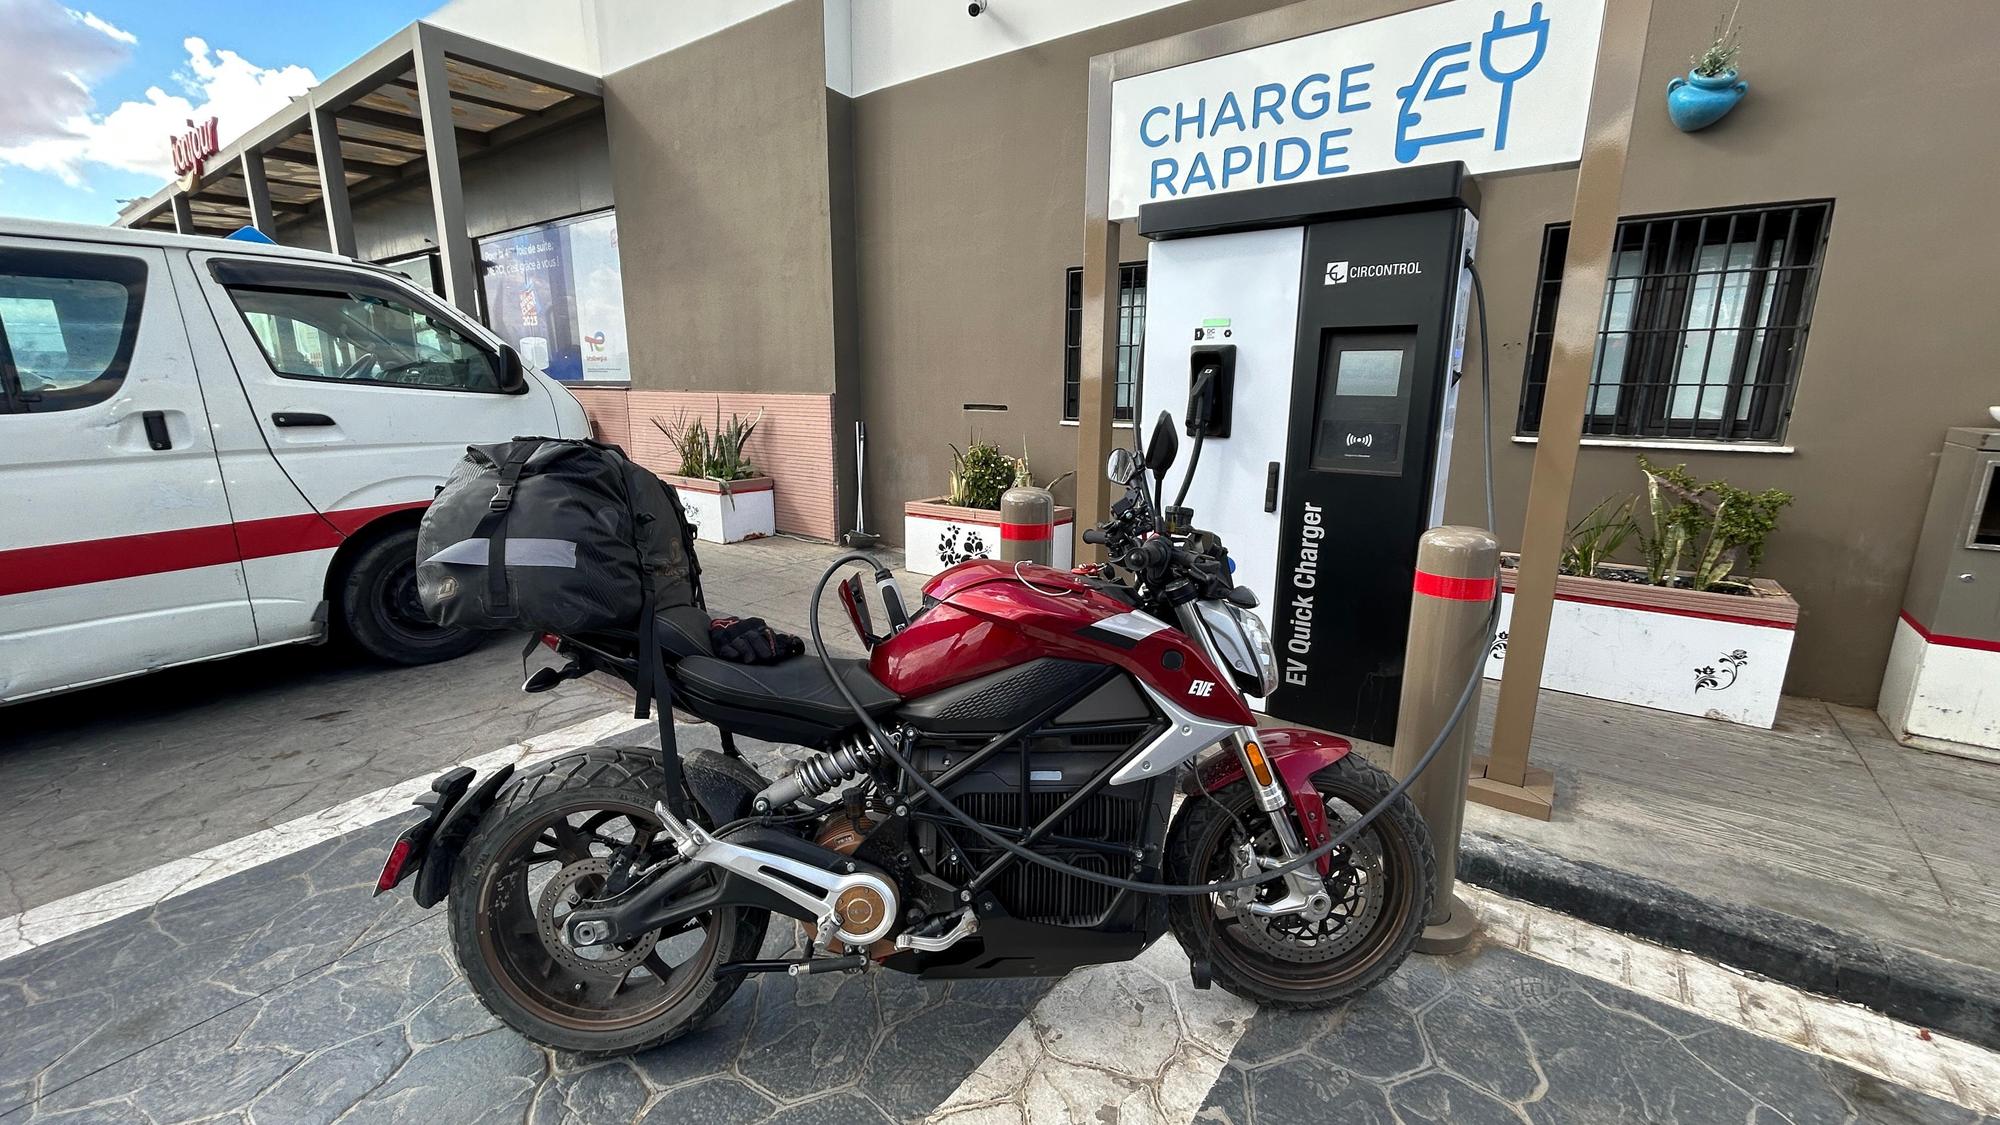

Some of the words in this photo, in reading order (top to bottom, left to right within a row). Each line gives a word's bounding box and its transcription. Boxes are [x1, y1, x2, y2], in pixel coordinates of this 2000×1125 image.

[1140, 63, 1374, 148] CHARGE
[170, 116, 219, 175] bonjour
[1151, 128, 1352, 198] RAPIDE
[528, 243, 536, 254] de
[1350, 262, 1422, 278] CIRCONTROL
[1293, 502, 1325, 589] Charger
[1288, 594, 1314, 654] Quick
[1188, 680, 1215, 697] EVE
[1286, 657, 1308, 686] EV
